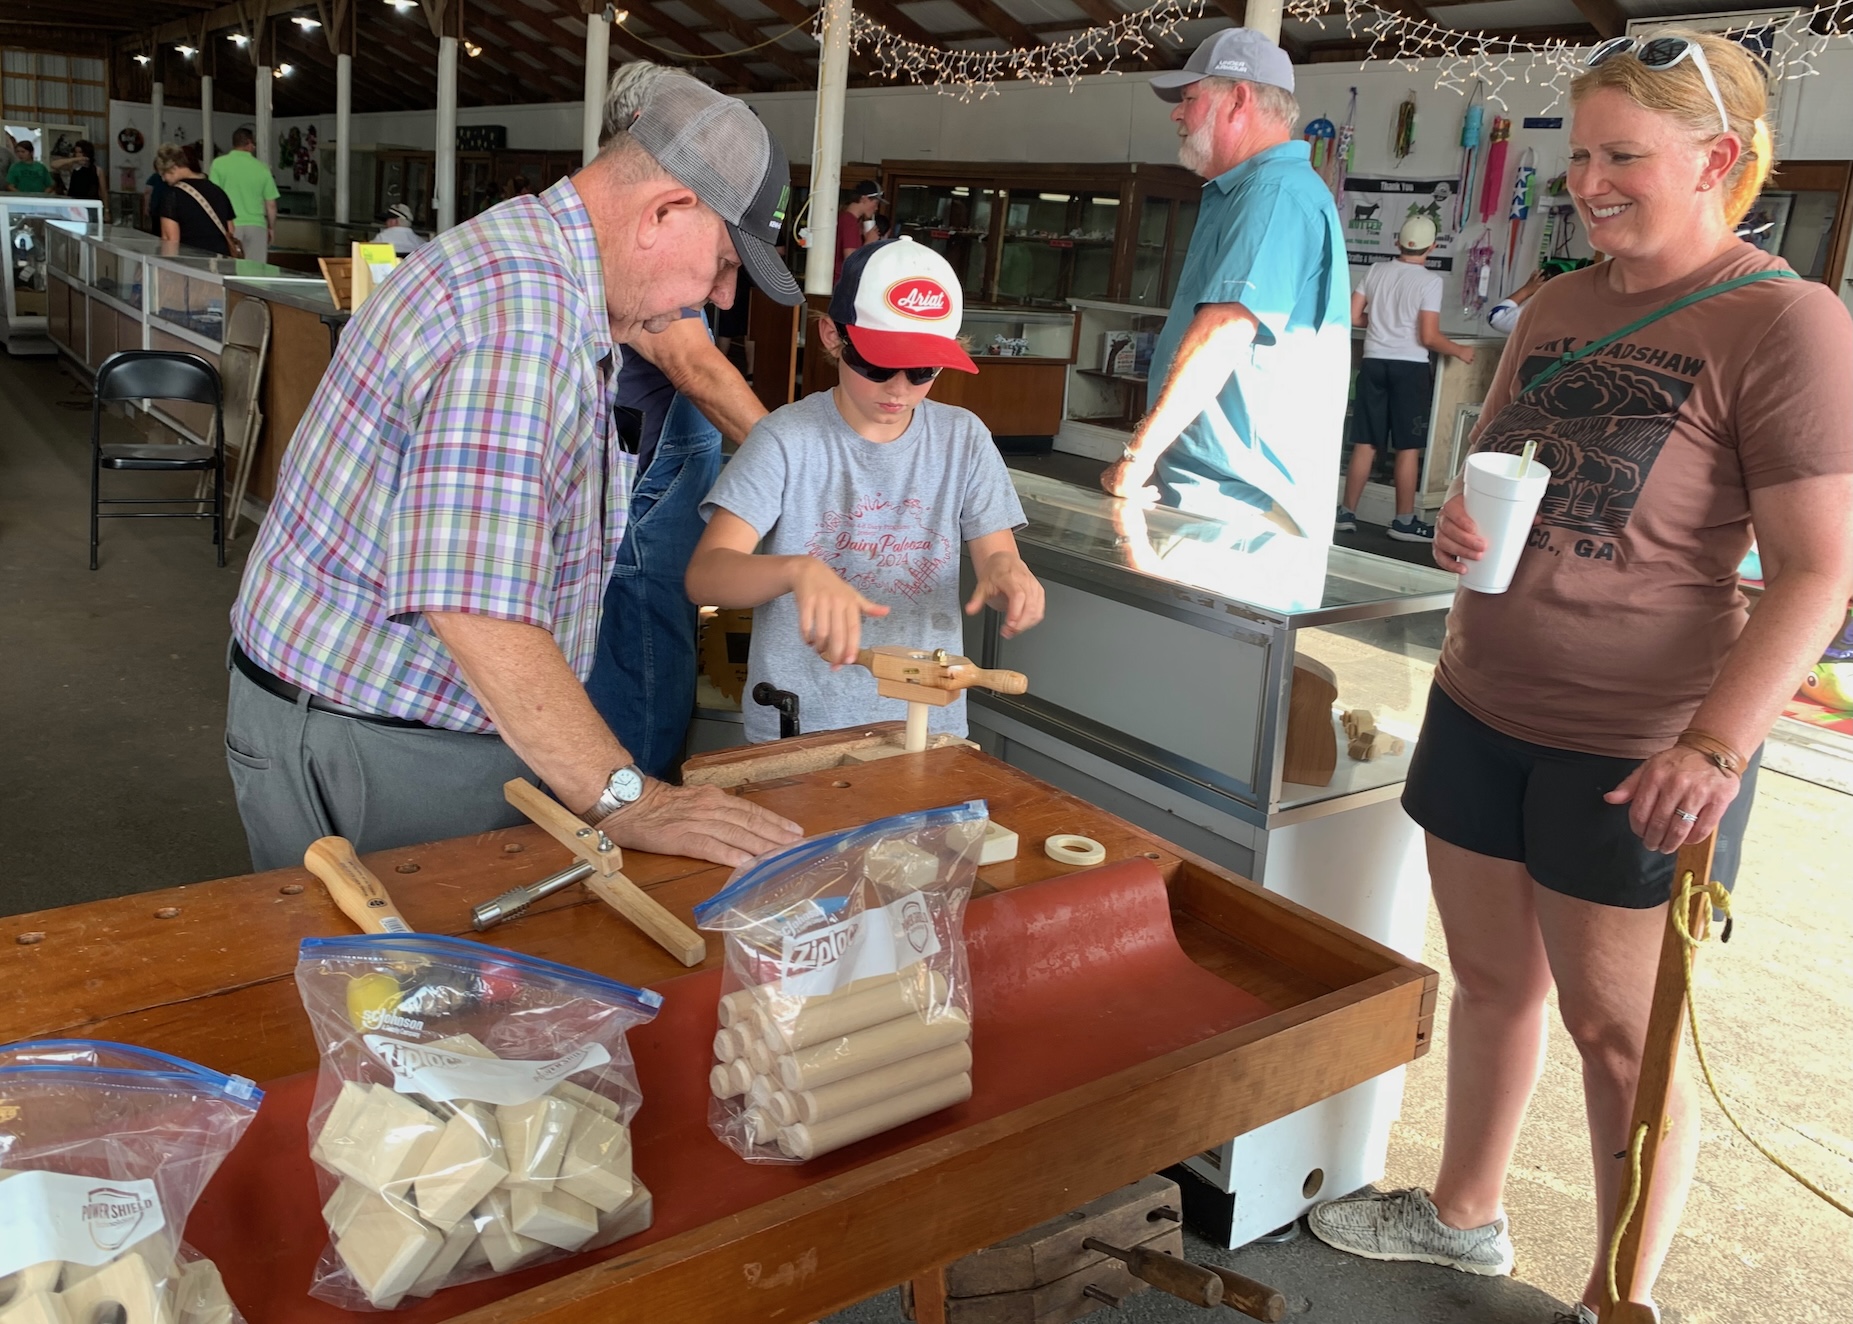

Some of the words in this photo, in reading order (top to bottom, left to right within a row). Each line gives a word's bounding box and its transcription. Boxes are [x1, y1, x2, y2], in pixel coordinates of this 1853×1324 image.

[1215, 65, 1248, 73] ARMOUR
[1380, 181, 1401, 192] Thank
[1402, 182, 1415, 192] You
[897, 288, 945, 309] Ariat
[835, 531, 878, 560] Dairy
[879, 533, 932, 553] Palooza
[1528, 528, 1561, 556] CO.,
[1574, 539, 1614, 561] GA
[876, 553, 909, 567] 2024
[791, 922, 859, 972] Ziploc
[376, 1041, 463, 1079] Ziploc
[82, 1203, 110, 1222] POWER
[111, 1199, 153, 1219] SHIELD
